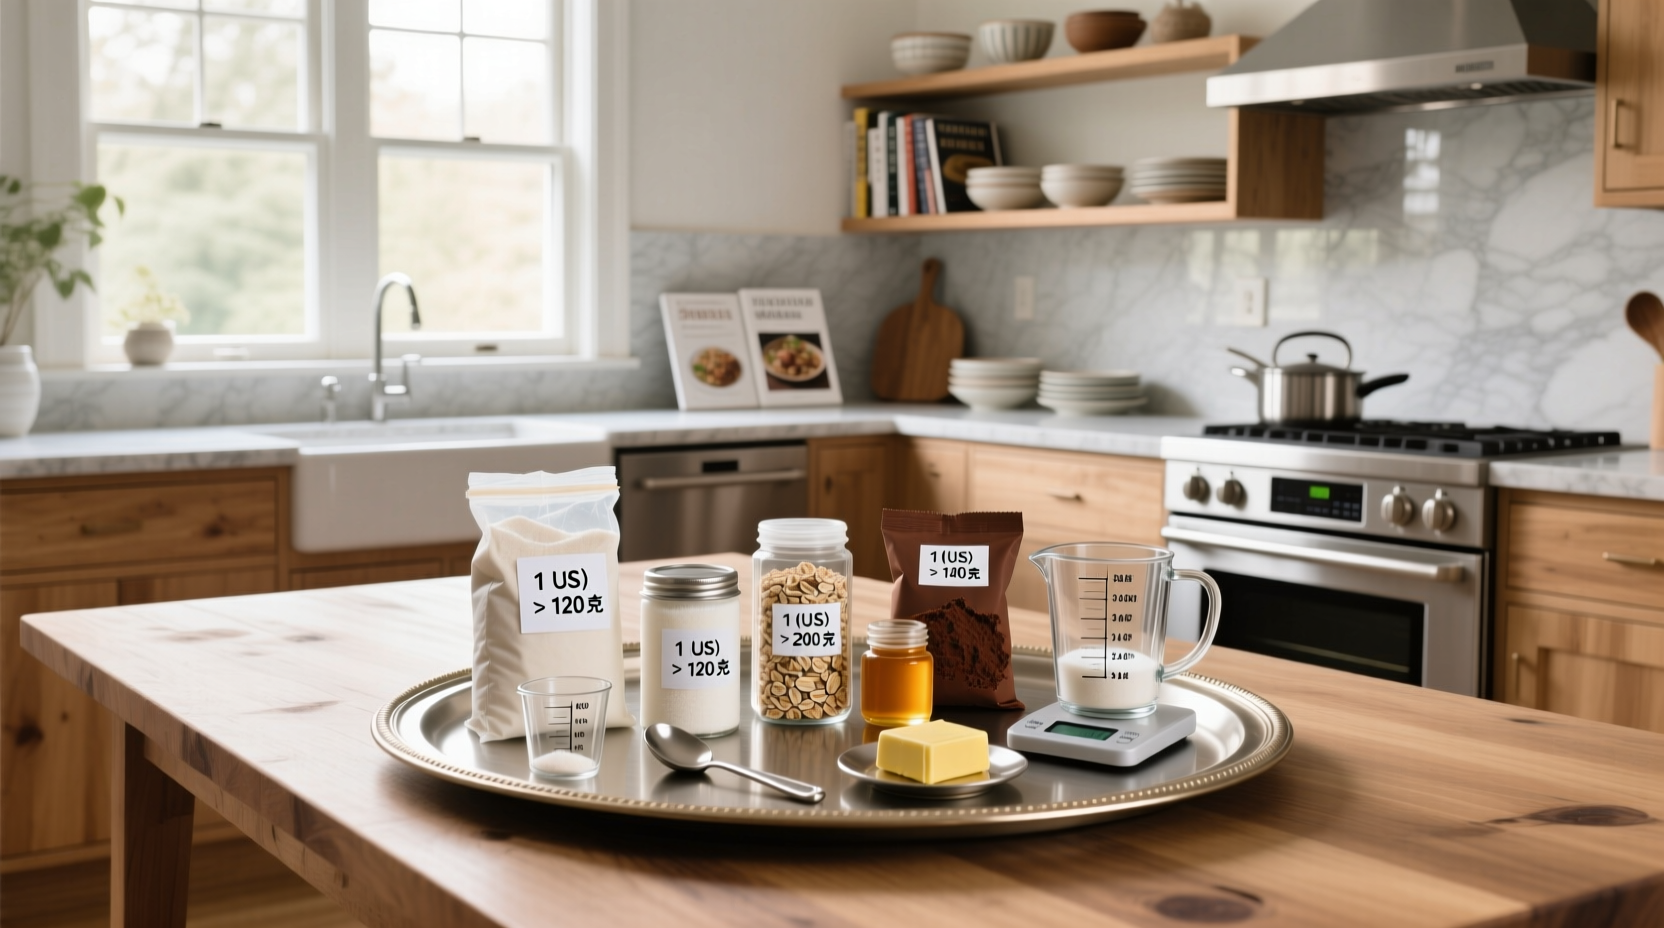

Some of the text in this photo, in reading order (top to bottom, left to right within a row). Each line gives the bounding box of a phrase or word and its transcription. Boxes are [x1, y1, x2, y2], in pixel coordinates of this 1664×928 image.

[930, 550, 973, 565] 1 (US)
[534, 568, 588, 591] 1 US)
[782, 611, 830, 629] 1 (US)
[675, 639, 720, 657] 1 US)
